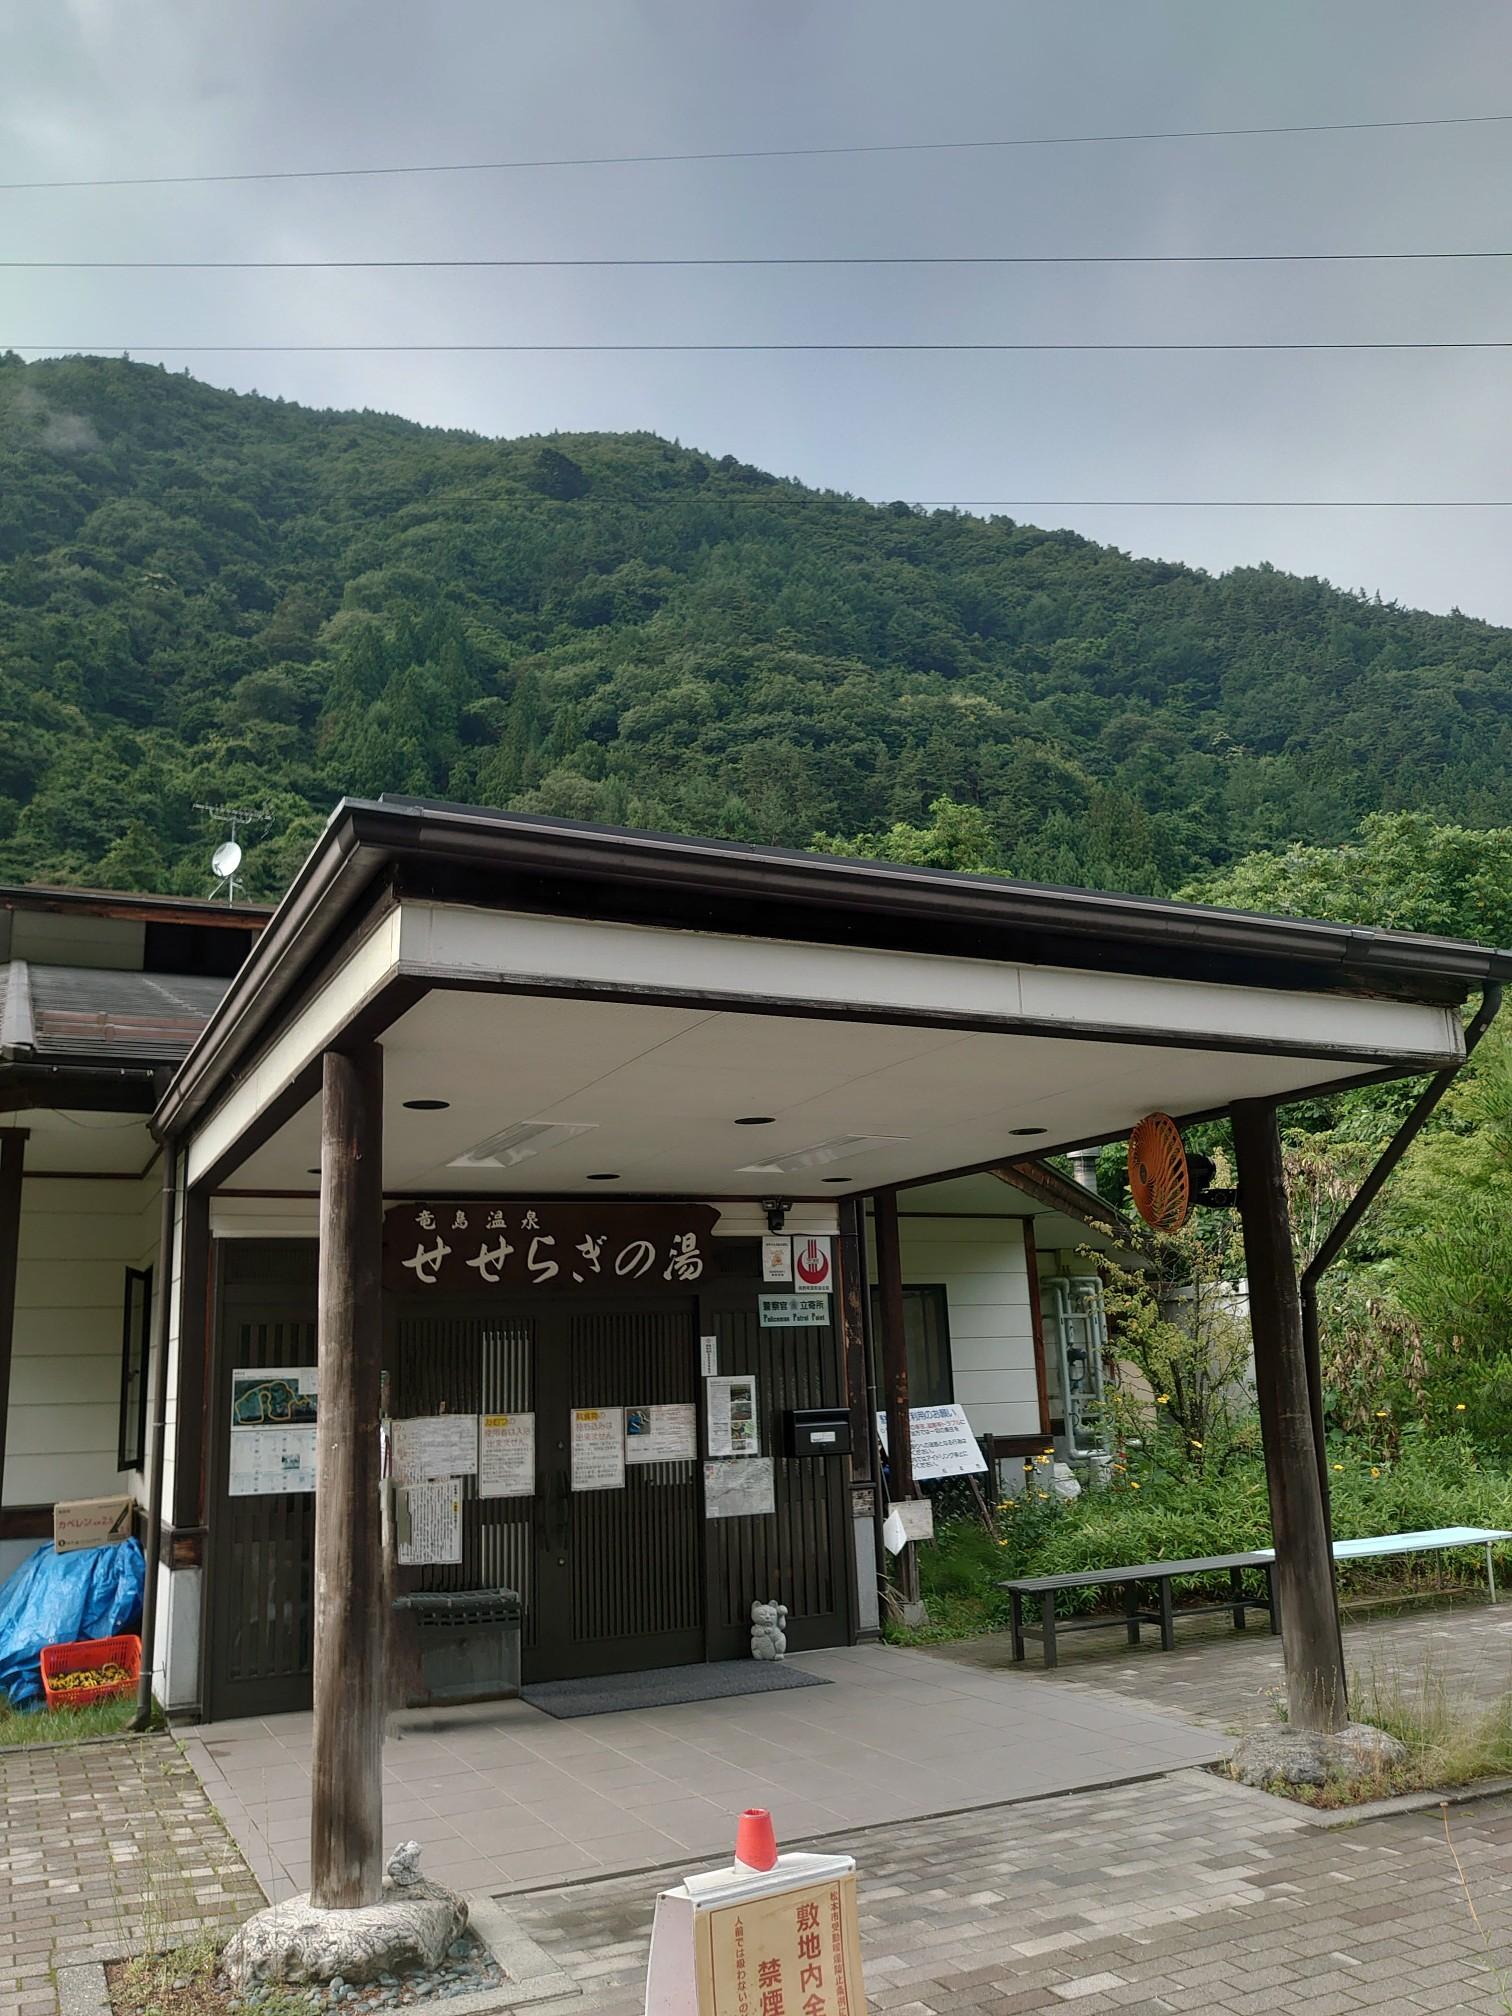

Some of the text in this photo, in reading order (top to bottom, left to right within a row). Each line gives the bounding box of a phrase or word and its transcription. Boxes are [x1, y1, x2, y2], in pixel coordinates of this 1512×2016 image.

[415, 1209, 541, 1230] 竜島温泉
[401, 1231, 703, 1284] せせらぎの湯
[734, 1915, 749, 2016] 人前では吸わないの
[757, 1957, 785, 2016] 禁煙
[796, 1901, 826, 2016] 敷地内全
